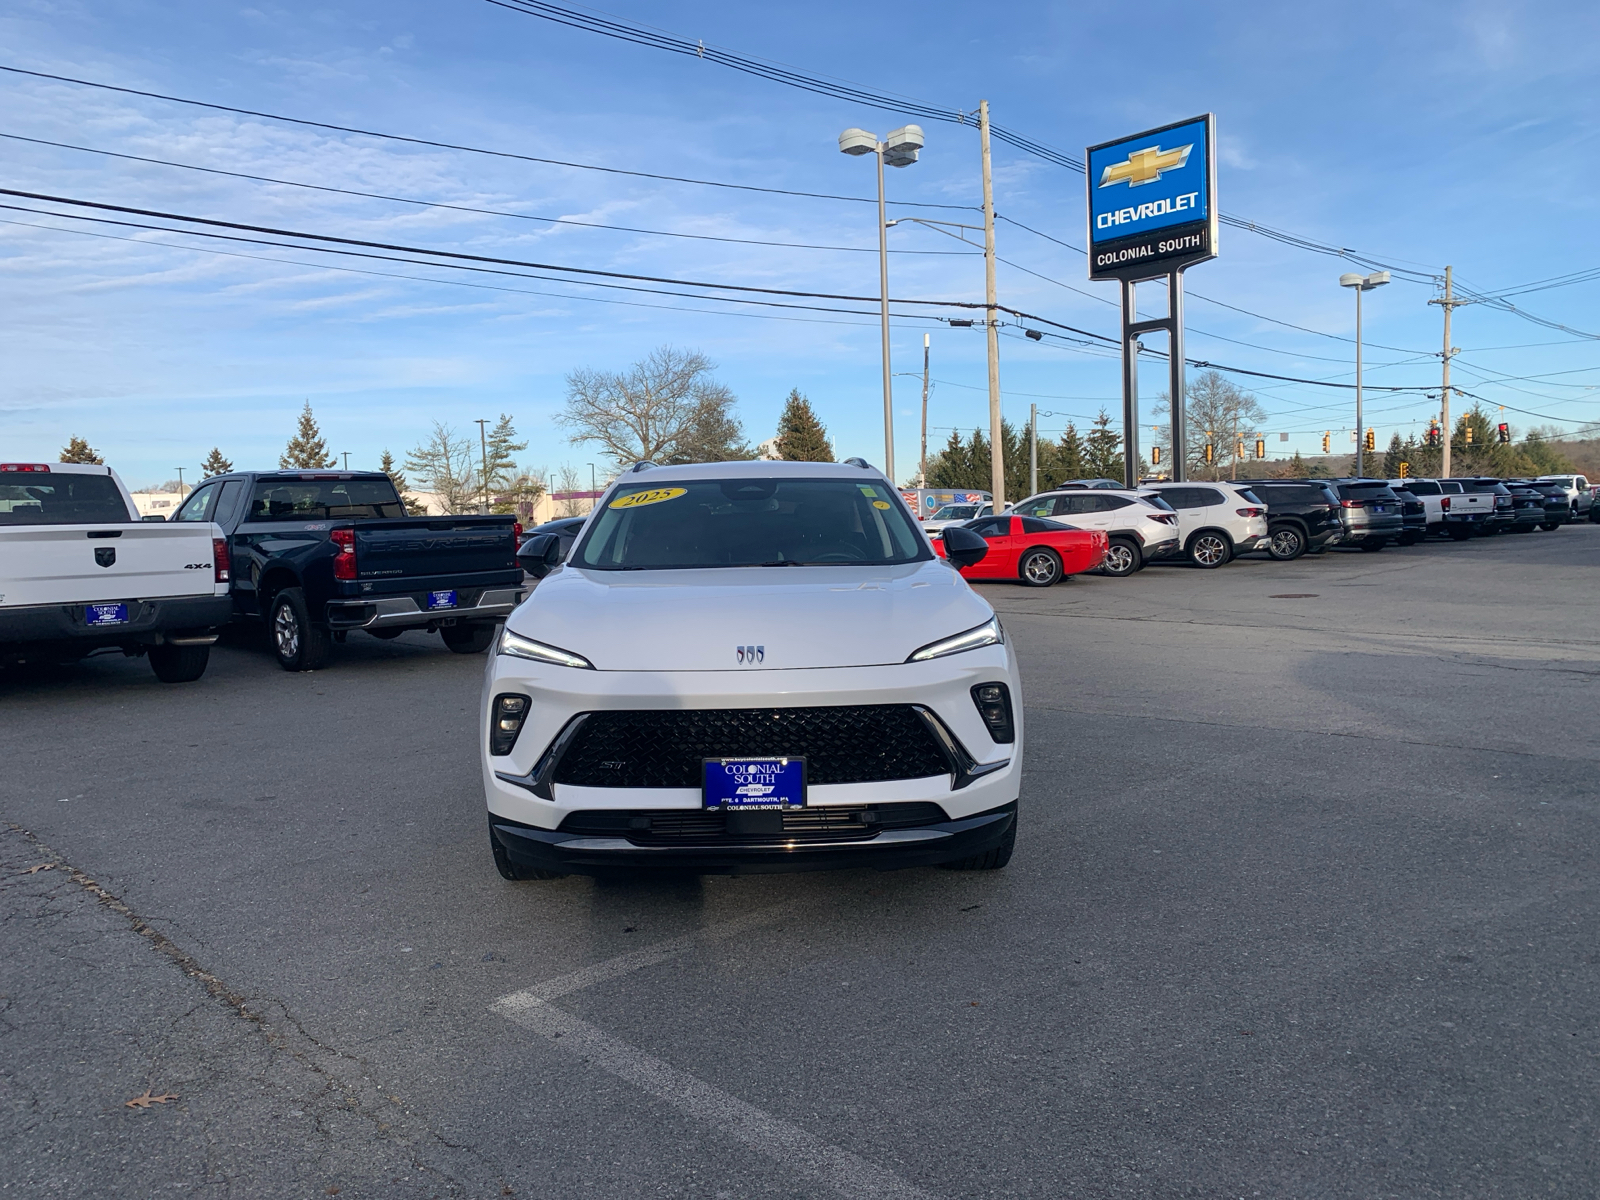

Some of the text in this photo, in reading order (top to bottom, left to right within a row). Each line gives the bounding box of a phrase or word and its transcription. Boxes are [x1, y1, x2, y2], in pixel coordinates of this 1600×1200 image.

[1097, 192, 1198, 229] CHEVROLET
[1097, 234, 1200, 266] COLONIAL SOUTH
[622, 488, 674, 507] 2025
[725, 764, 785, 775] COLONIAL
[734, 774, 775, 784] SOUTH
